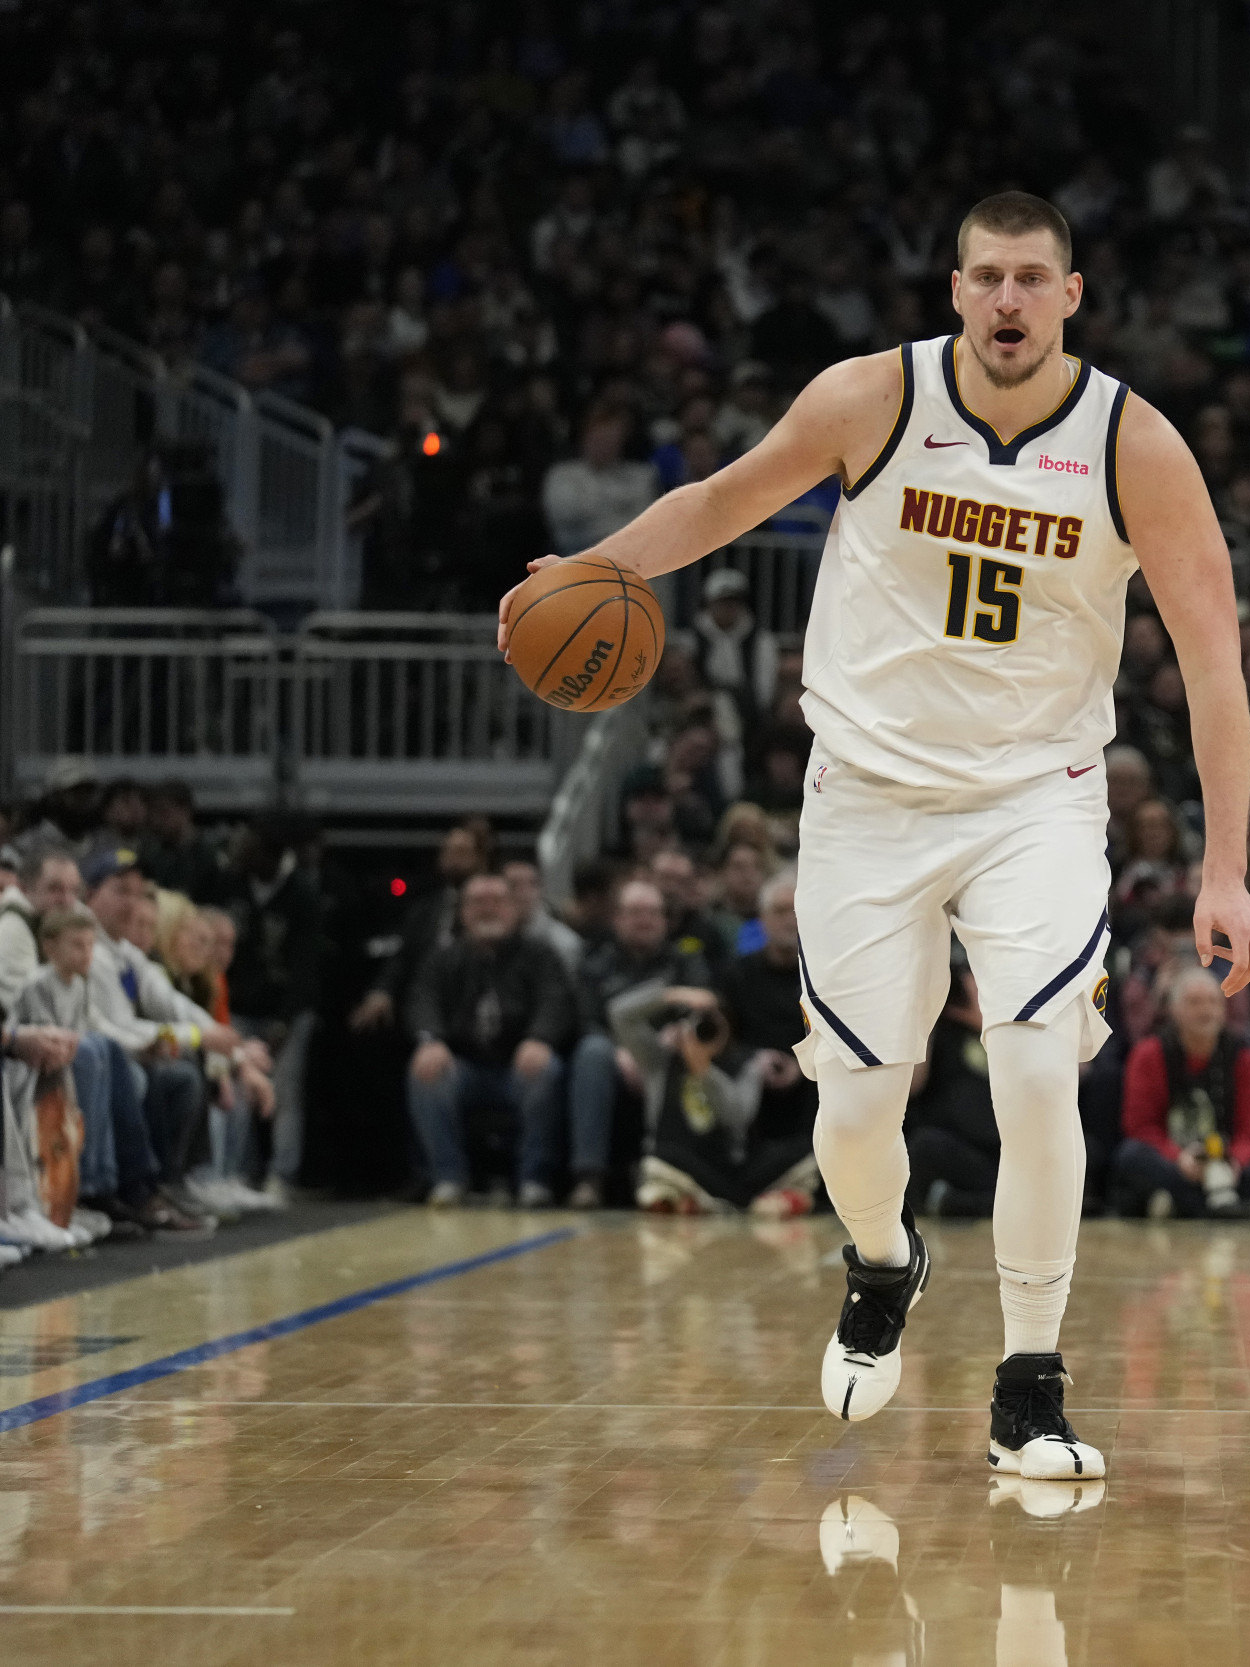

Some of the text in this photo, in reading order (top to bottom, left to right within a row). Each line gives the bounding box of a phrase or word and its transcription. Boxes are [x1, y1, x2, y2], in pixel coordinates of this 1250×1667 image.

[1038, 455, 1089, 475] ibotta
[900, 486, 1084, 559] NUGGETS
[944, 551, 1024, 645] 15
